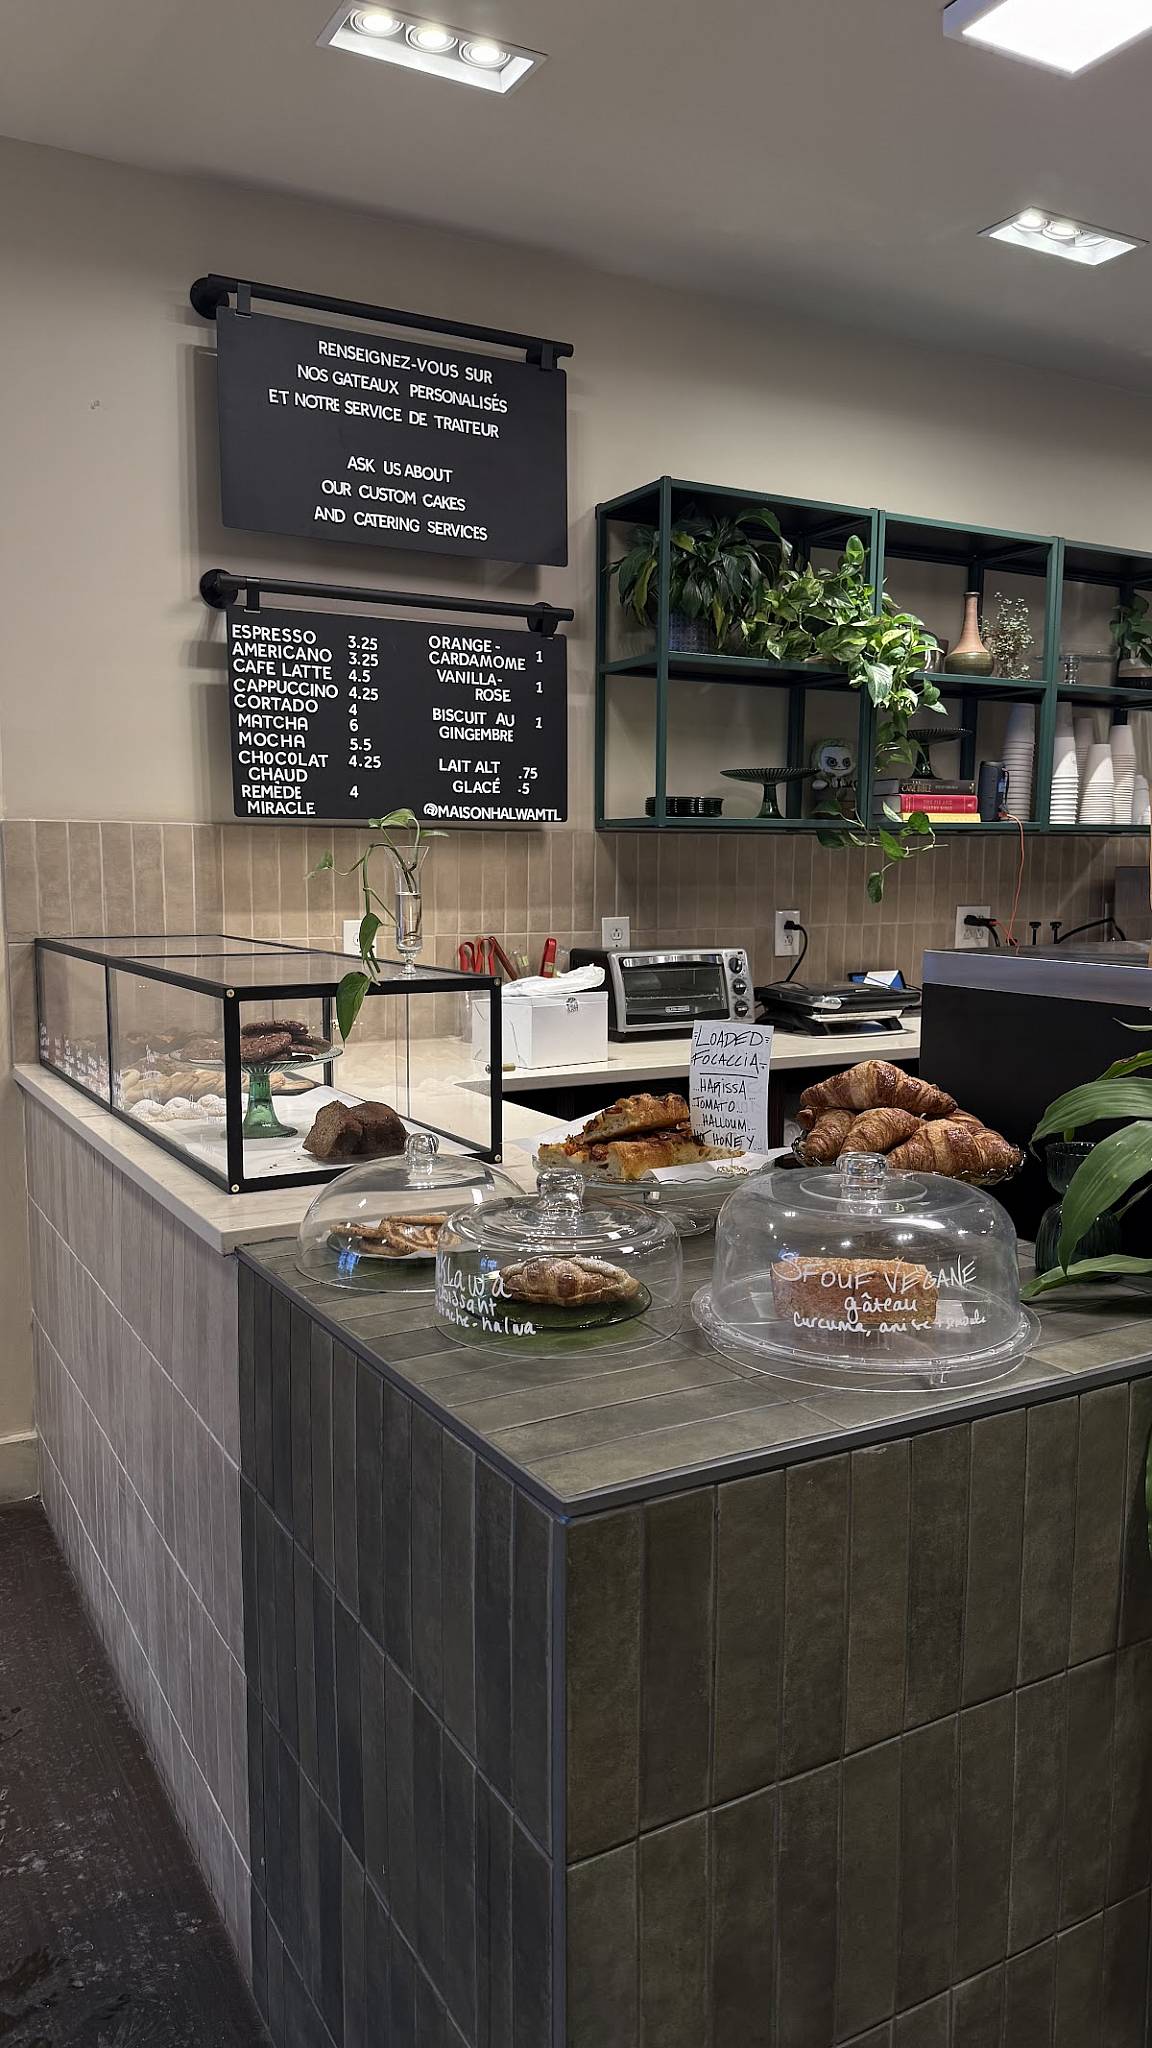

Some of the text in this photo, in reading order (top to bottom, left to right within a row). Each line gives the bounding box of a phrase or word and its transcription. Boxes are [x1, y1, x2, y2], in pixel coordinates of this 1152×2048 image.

[318, 340, 493, 385] RENSEIGNEZ-VOUS SUR
[297, 364, 508, 413] NOS GATEAUX PERSONALISÉS
[269, 389, 500, 438] ET NOTRE SERVICE DE TRAITEUR
[347, 456, 453, 483] ASK US ABOUT
[322, 480, 466, 511] OUR CUSTOM CAKES
[314, 506, 488, 541] AND CATERING SERVICES
[232, 624, 378, 650] ESPRESSO 3.25
[233, 642, 379, 667] AMERICANO 3.25
[428, 651, 543, 671] CARDAMOME 1
[233, 659, 371, 683] CAFE LATTE 4.5
[233, 678, 379, 701] CAPPUCCINO 4.25
[475, 682, 543, 702] ROSE 1
[234, 694, 357, 716] CORTADO 4
[238, 714, 358, 732] MATCHA 6
[432, 708, 542, 729] BISCUIT AU 1
[239, 732, 372, 751] MOCHA 5.5
[439, 726, 514, 742] GINGEMBRE
[239, 751, 382, 769] CHOCOLAT 4.25
[439, 759, 538, 779] LAIT ALT .75
[249, 767, 308, 783] CHAUD
[350, 786, 358, 798] 4
[453, 778, 500, 794] GLACÉ
[248, 801, 316, 815] MIRACLE
[423, 803, 562, 821] @MAISONHALWAMTL
